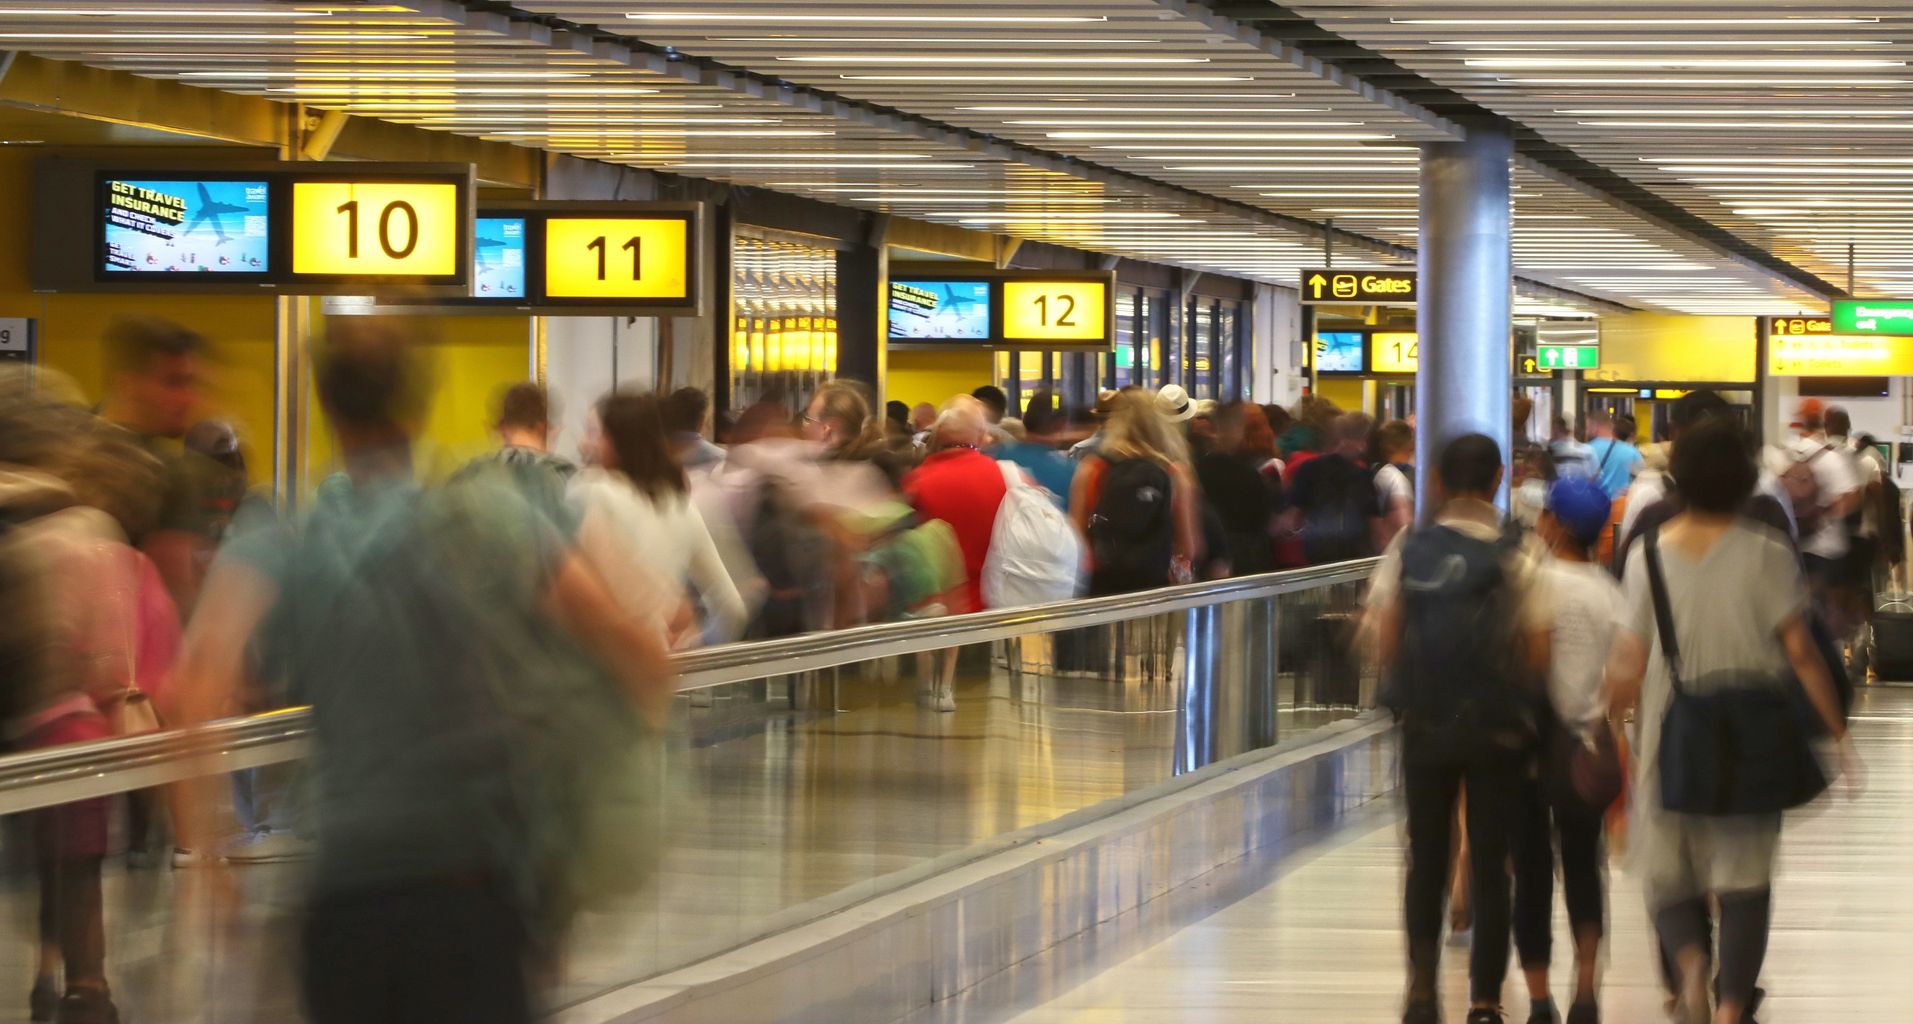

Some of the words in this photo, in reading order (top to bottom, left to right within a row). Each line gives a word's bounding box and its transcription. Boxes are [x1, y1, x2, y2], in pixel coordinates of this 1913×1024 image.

[111, 193, 185, 222] INSURANCE
[112, 180, 136, 195] GET
[139, 187, 187, 210] TRAVEL
[111, 207, 129, 217] AND
[129, 211, 156, 224] CHECK
[111, 215, 136, 227] WHAT
[136, 221, 145, 229] IT
[337, 199, 418, 260] 10
[586, 235, 641, 281] 11
[892, 290, 938, 308] INSURANCE
[1361, 275, 1412, 294] Gates
[1033, 294, 1076, 327] 12
